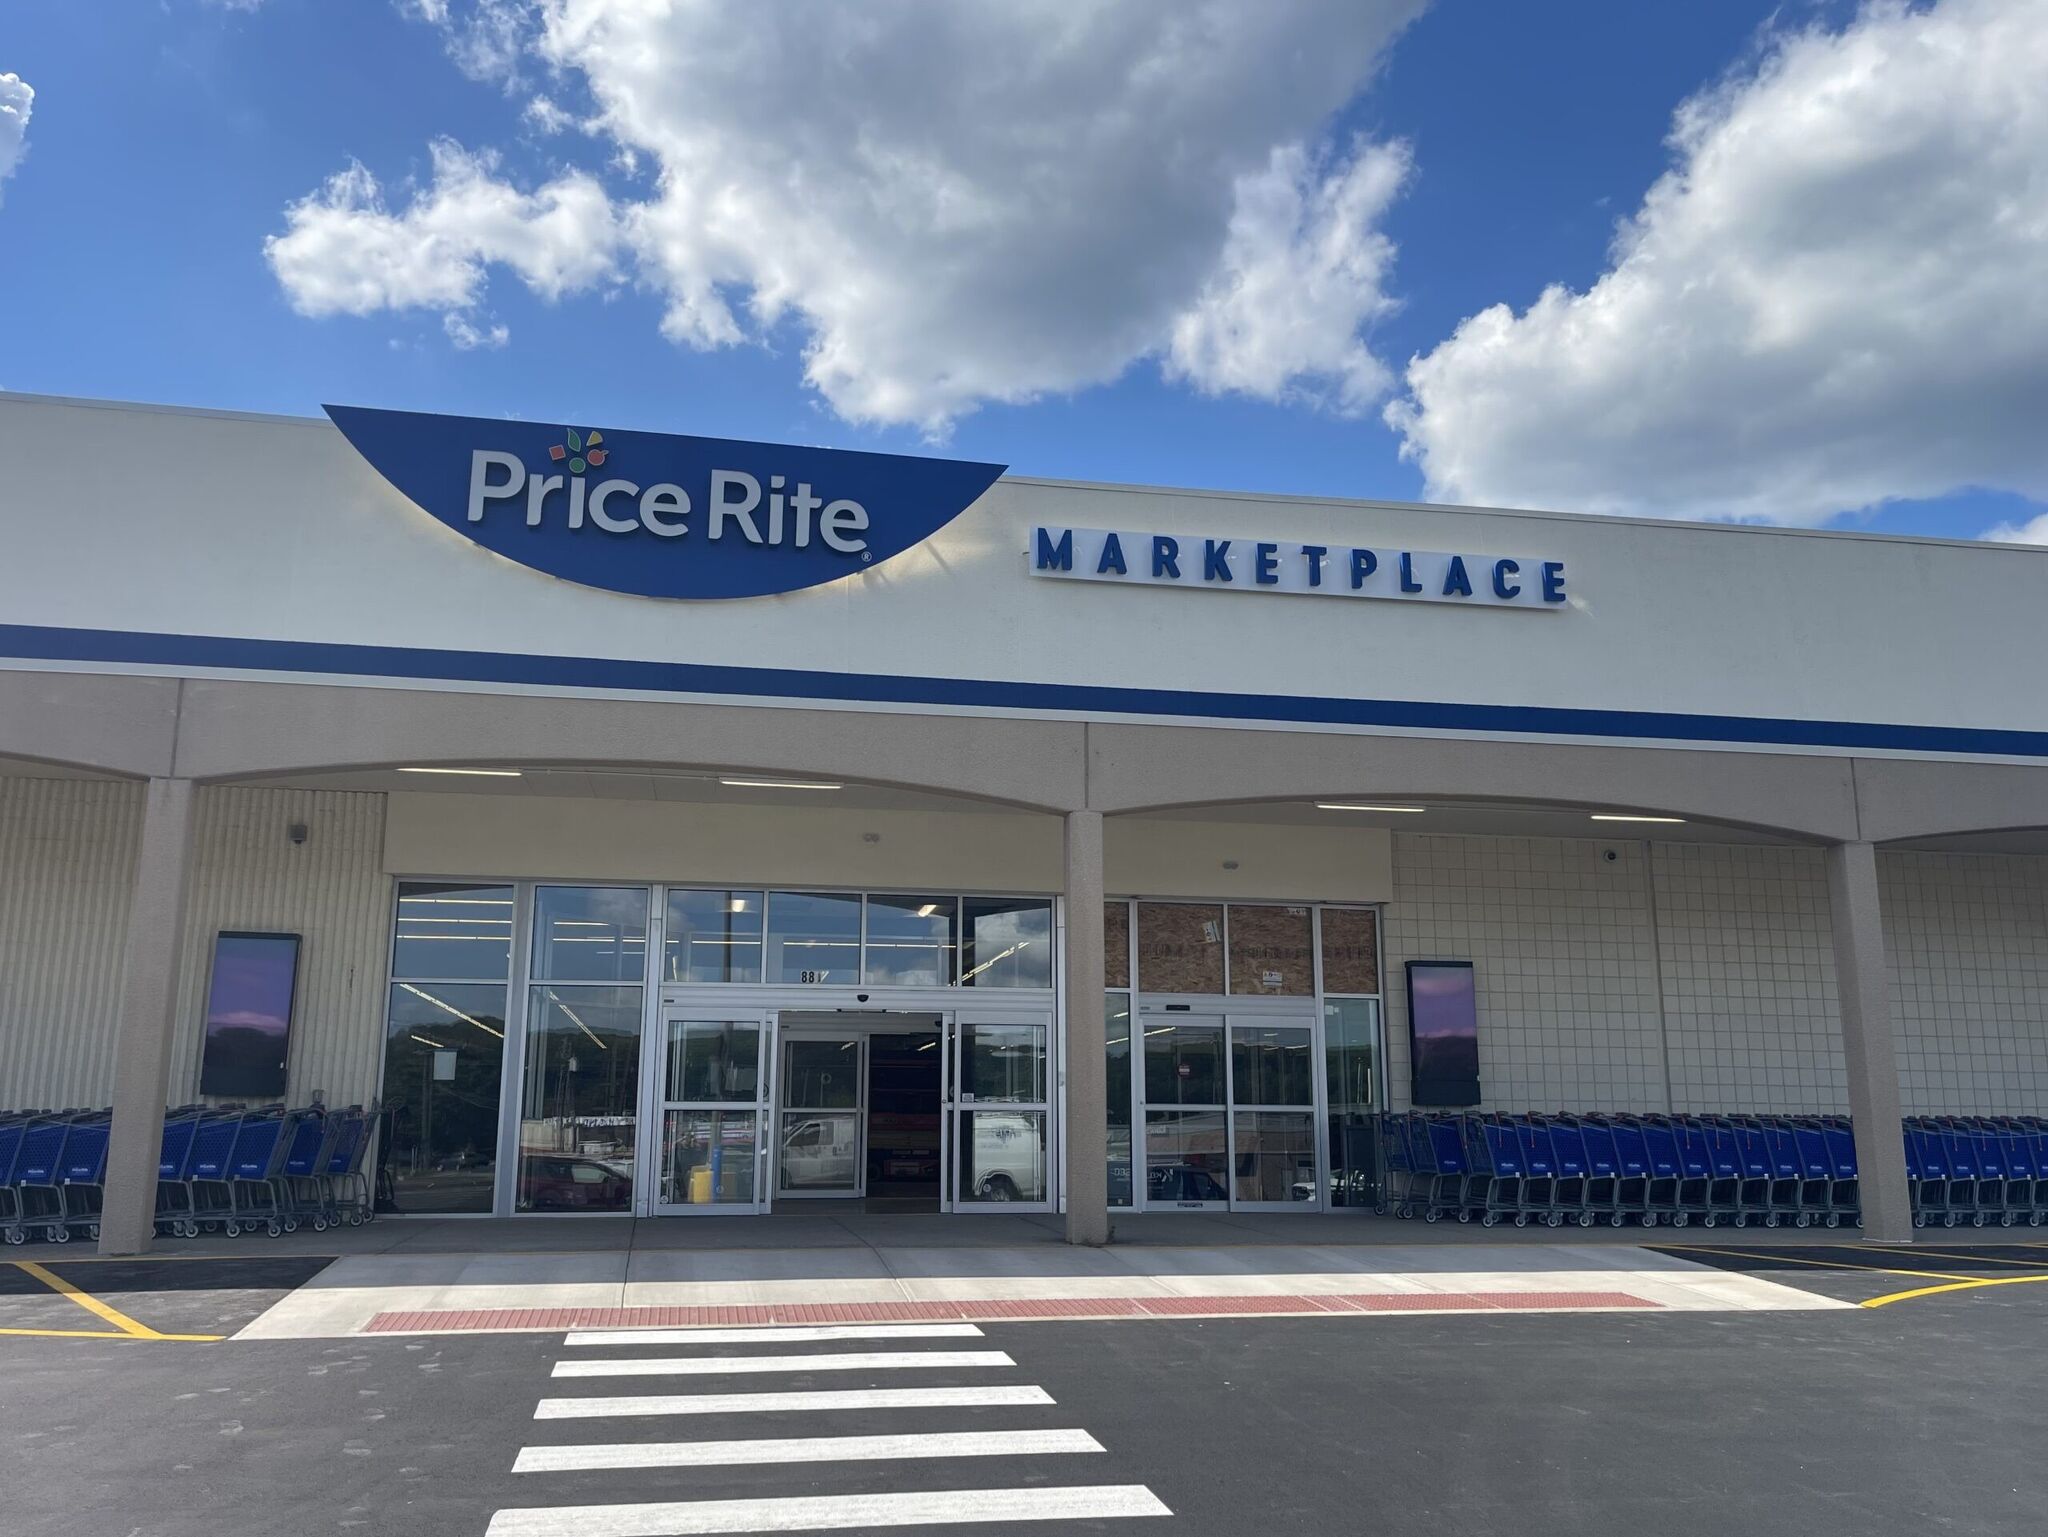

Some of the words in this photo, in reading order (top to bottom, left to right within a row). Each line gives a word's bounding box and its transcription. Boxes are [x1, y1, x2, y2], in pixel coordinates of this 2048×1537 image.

[467, 449, 692, 537] Price
[707, 469, 870, 553] Rite
[1036, 527, 1567, 602] MARKETPLACE
